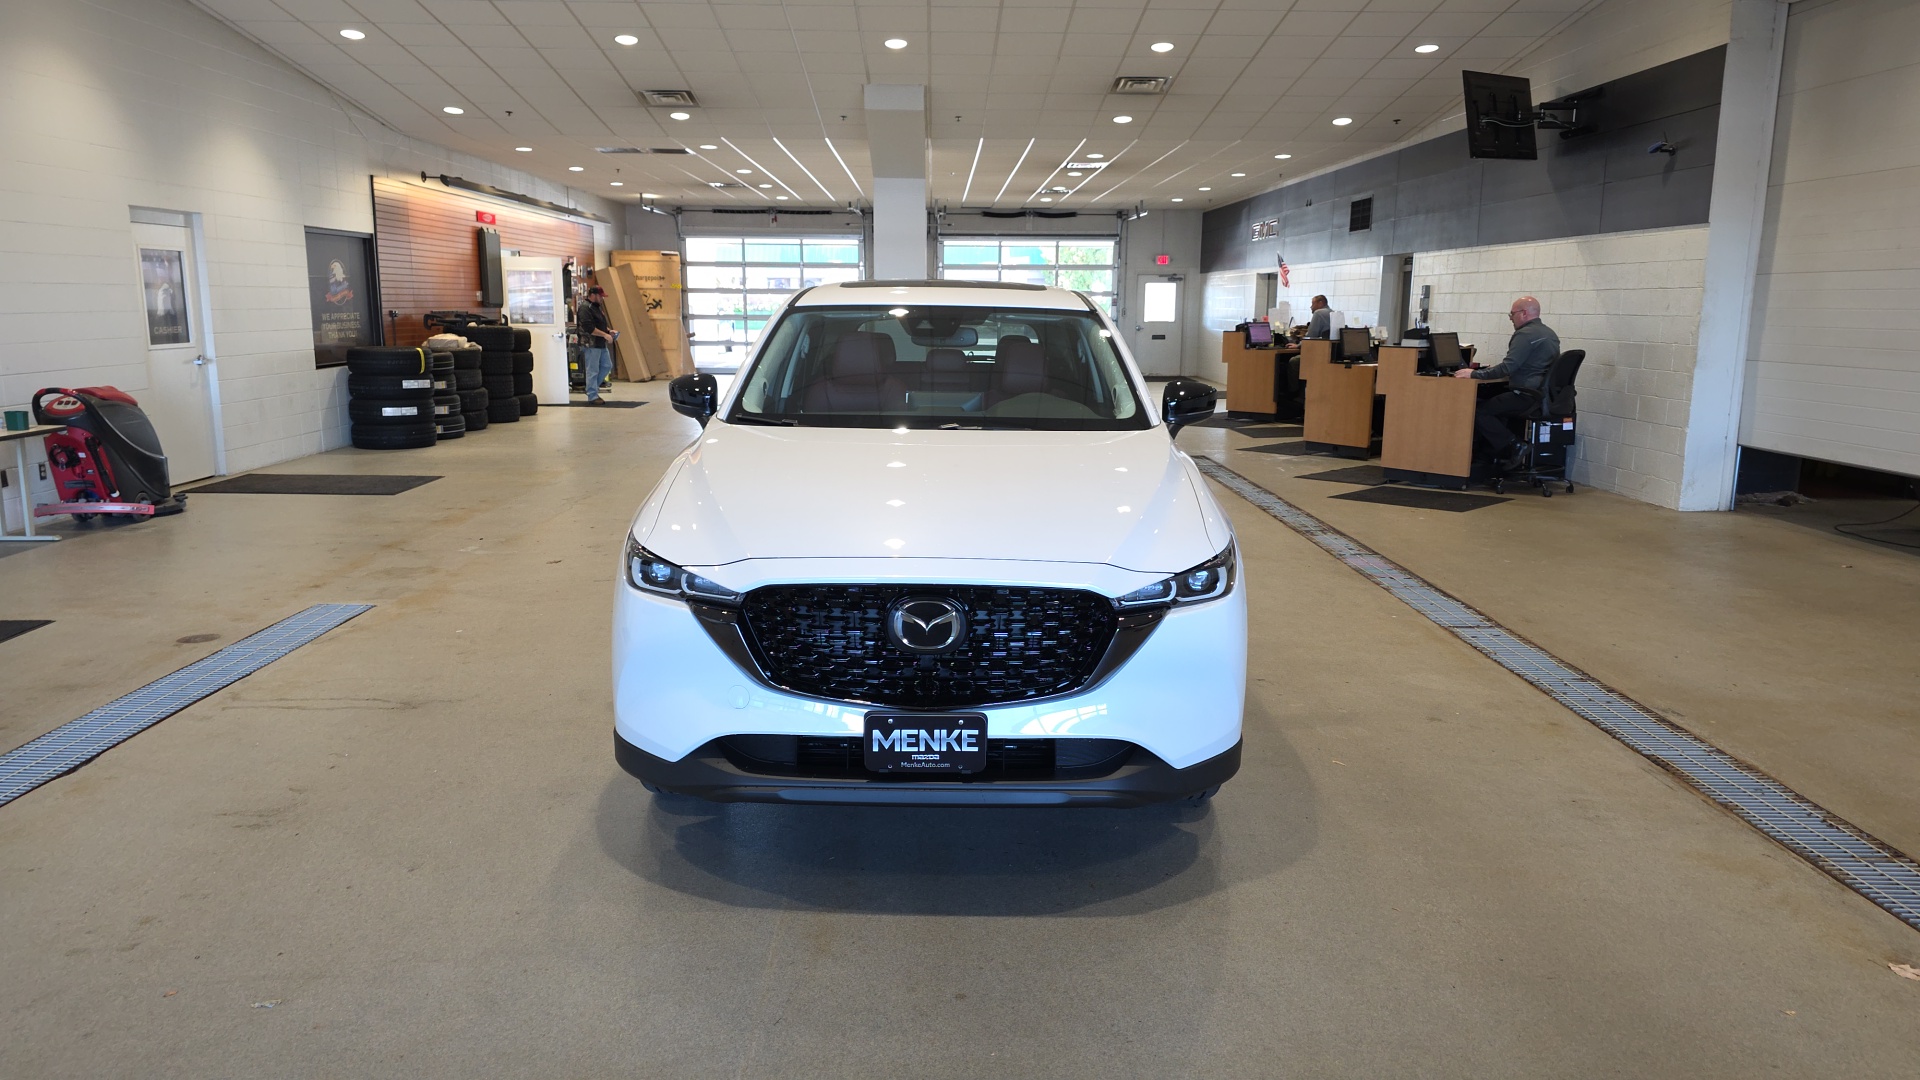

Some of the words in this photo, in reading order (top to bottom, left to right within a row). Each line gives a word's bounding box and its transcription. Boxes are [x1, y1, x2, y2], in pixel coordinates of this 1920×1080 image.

[331, 312, 360, 320] APPRECIATE
[154, 326, 182, 334] CASHIER
[322, 322, 336, 330] YOUR
[328, 331, 345, 339] THANK
[872, 729, 979, 752] MENKE
